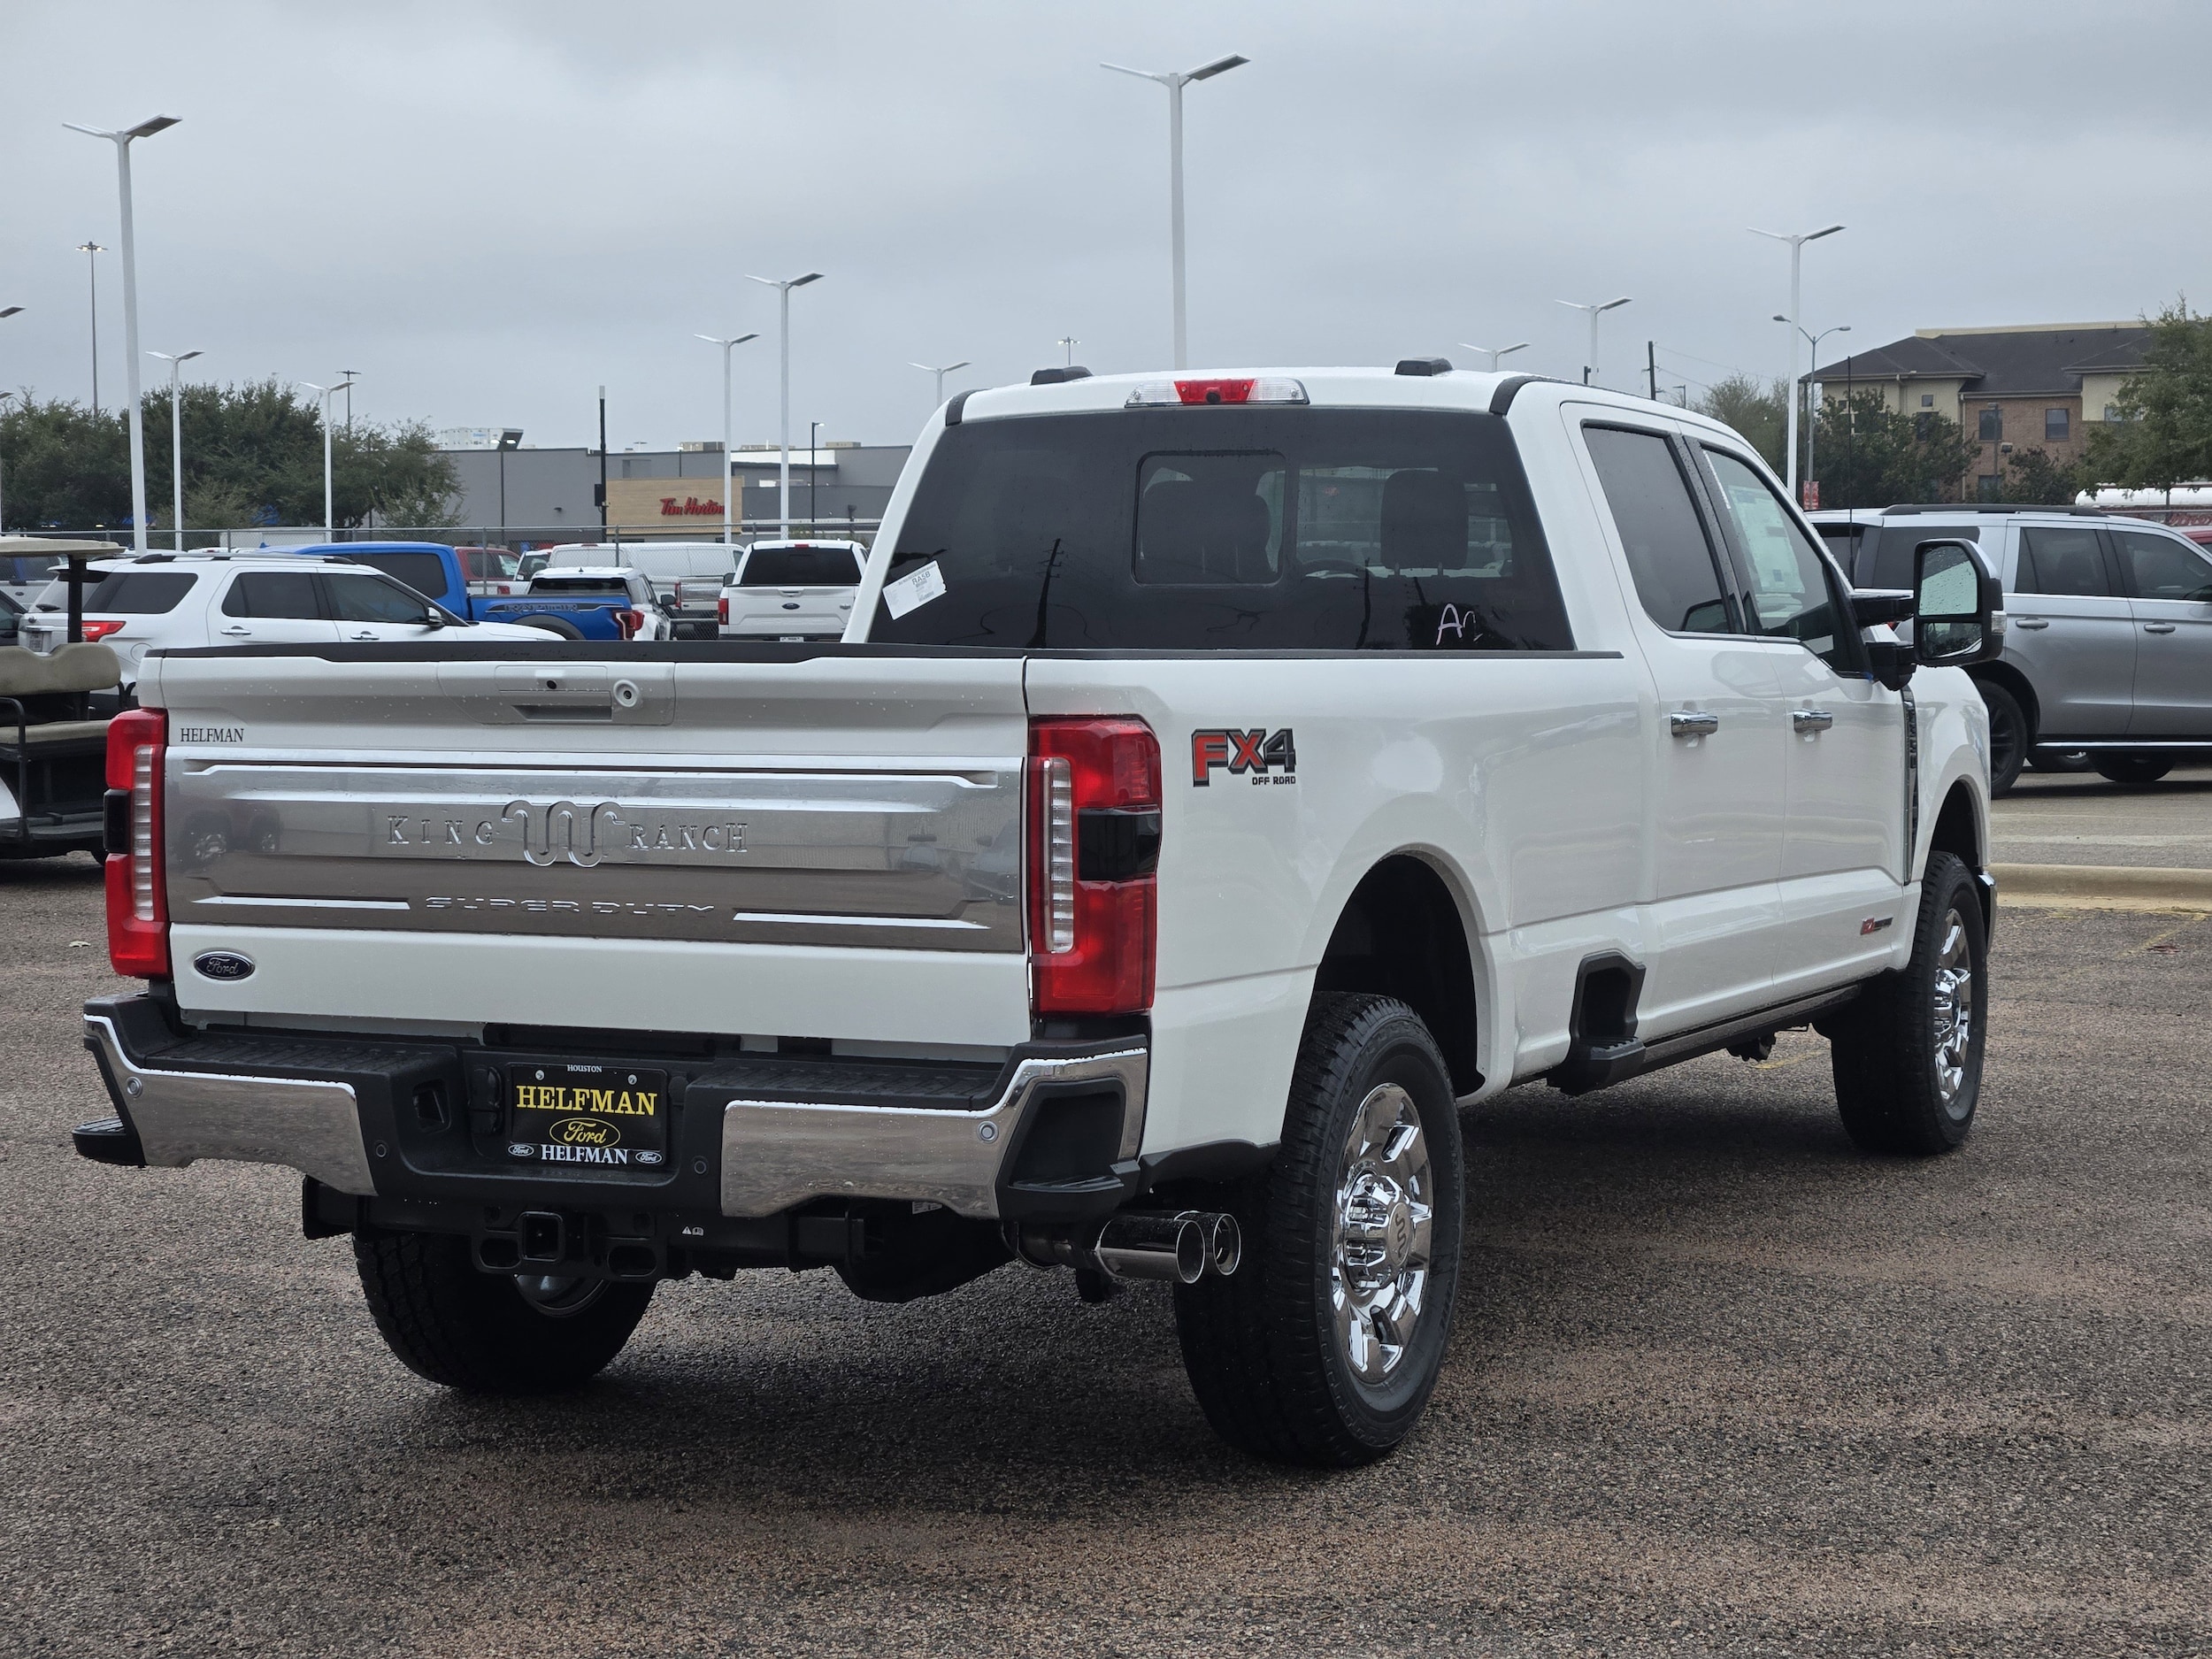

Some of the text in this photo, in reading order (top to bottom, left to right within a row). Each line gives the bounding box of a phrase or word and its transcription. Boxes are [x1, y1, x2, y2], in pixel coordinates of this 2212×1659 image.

[659, 496, 725, 516] Tim Horton
[180, 727, 244, 742] HELFMAN
[1191, 728, 1296, 787] FX4
[1252, 776, 1296, 786] OFF ROAD
[387, 815, 749, 853] KING RANCH
[205, 956, 240, 974] Ford
[566, 1064, 603, 1073] HOUSTON
[516, 1085, 657, 1116] HELFMAN
[563, 1120, 608, 1144] Ford
[541, 1144, 628, 1164] HELFMAN
